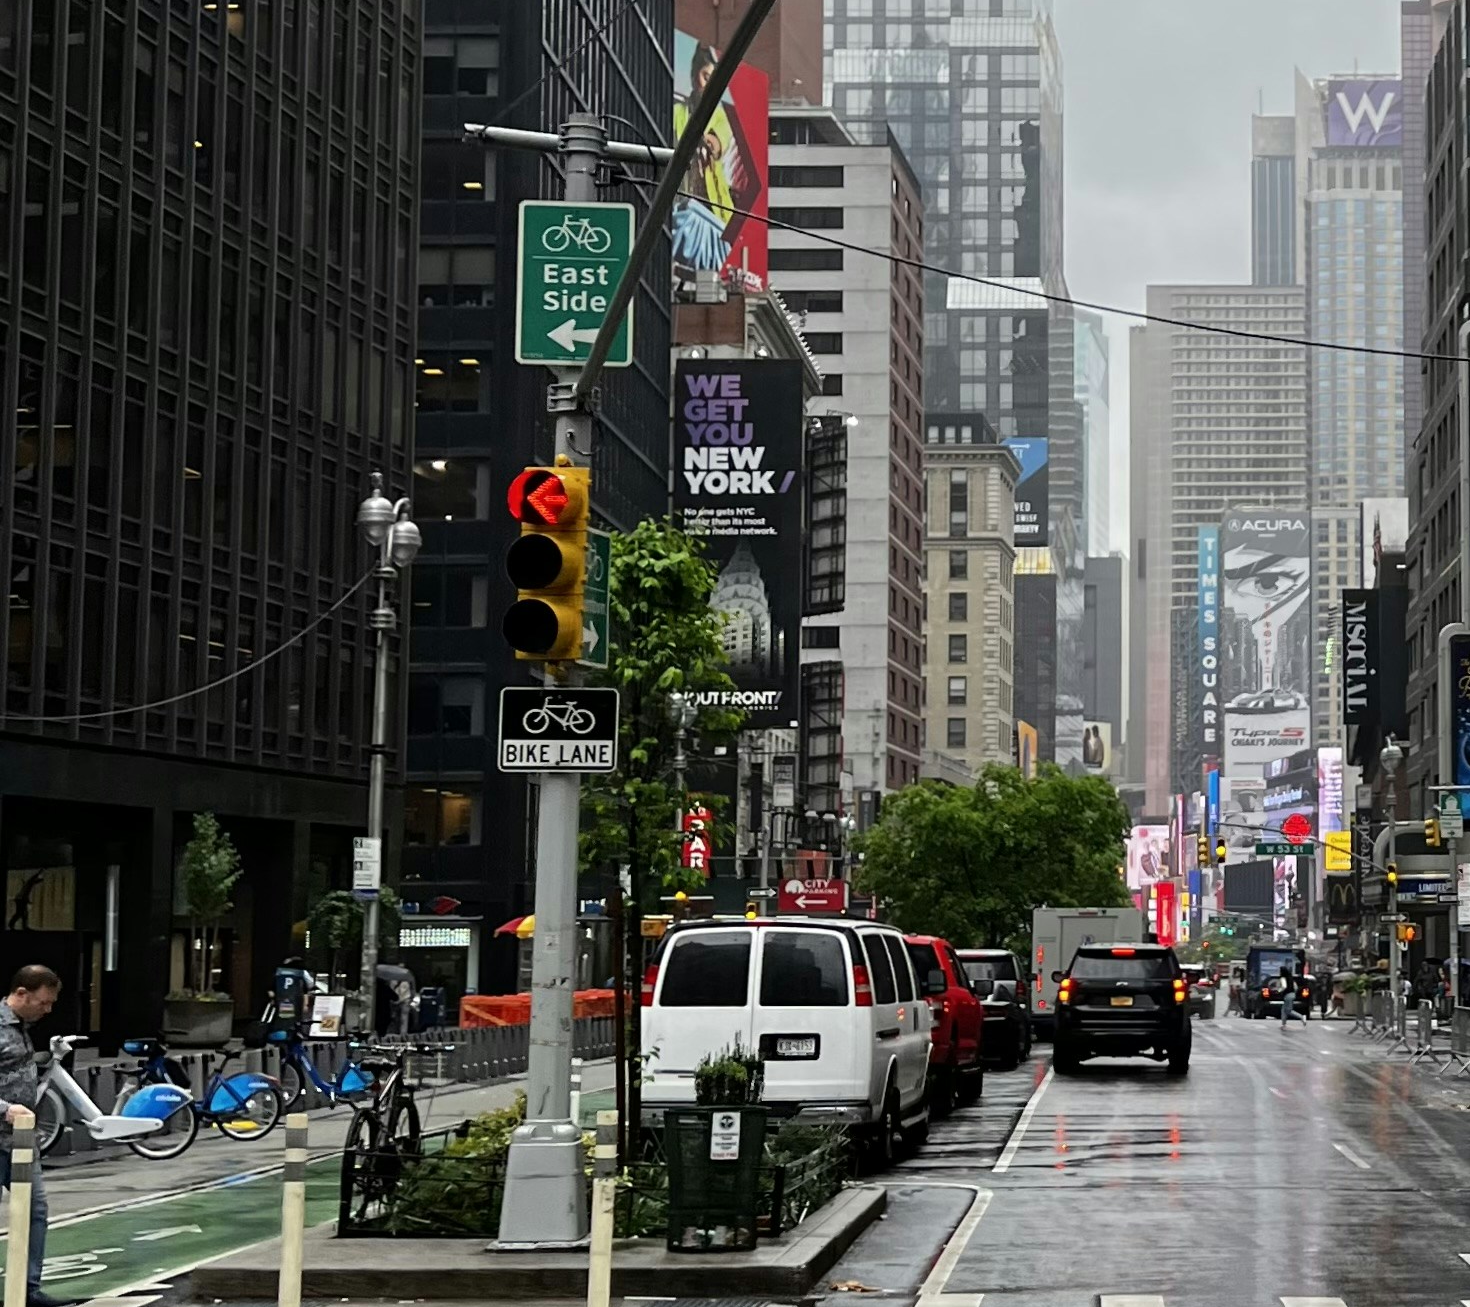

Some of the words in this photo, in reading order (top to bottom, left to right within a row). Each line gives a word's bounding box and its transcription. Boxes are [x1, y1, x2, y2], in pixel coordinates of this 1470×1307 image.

[1336, 92, 1394, 134] W
[543, 264, 609, 285] East
[543, 290, 607, 312] Side
[685, 374, 741, 397] WE
[684, 398, 749, 422] GET
[685, 423, 754, 445] YOU
[684, 447, 765, 470] NEW
[683, 471, 775, 494] YORK
[711, 517, 731, 525] than
[732, 517, 743, 525] its
[716, 508, 735, 517] gets
[736, 507, 755, 515] NYC
[740, 527, 778, 535] network.
[1242, 520, 1305, 531] ACURA
[1203, 537, 1217, 623] TIMES
[1203, 637, 1218, 742] SQUARE
[1230, 727, 1276, 738] Type
[1279, 727, 1306, 737] S
[1267, 737, 1305, 747] JOURNEY
[506, 744, 550, 763] BIKE
[559, 744, 610, 763] LANE
[1277, 845, 1290, 853] 53
[805, 879, 829, 888] CITY
